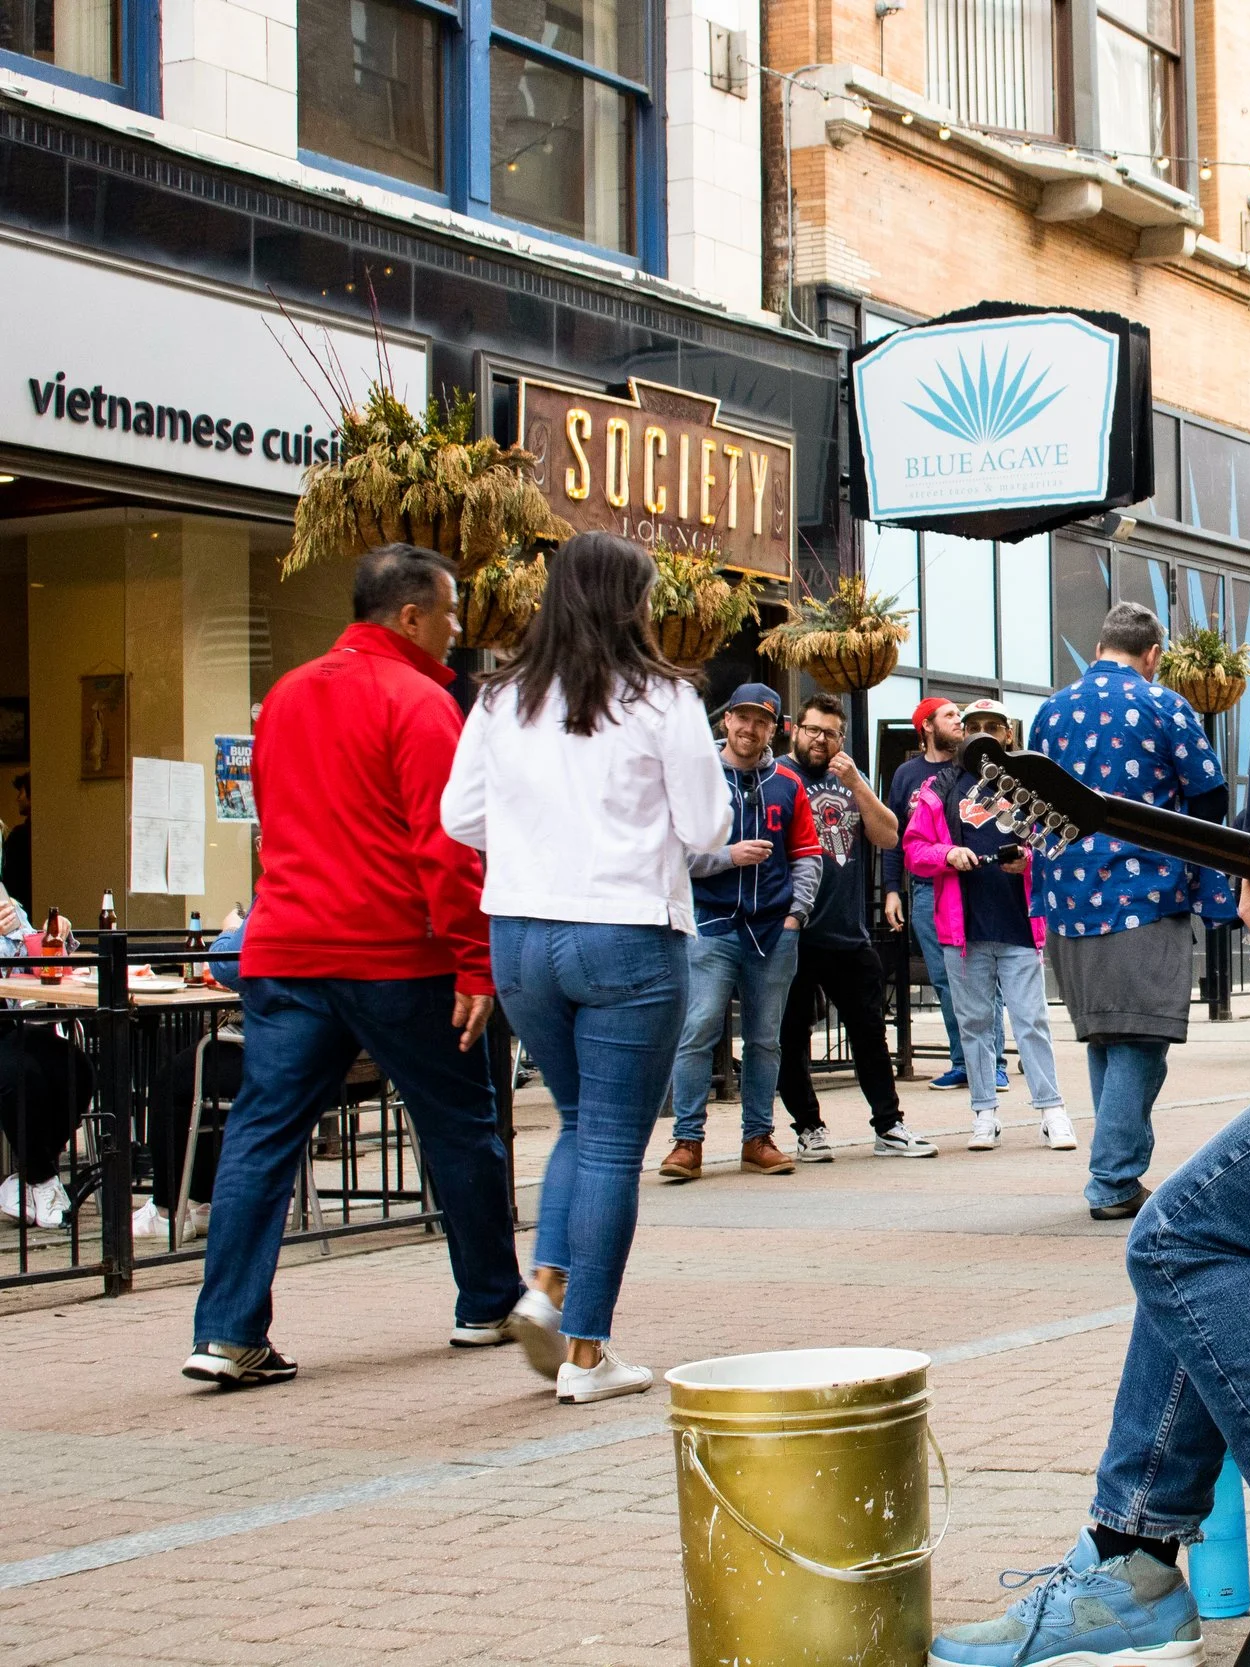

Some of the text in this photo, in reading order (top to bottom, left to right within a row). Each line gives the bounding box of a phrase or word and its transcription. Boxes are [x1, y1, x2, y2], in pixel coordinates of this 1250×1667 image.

[29, 371, 254, 455] vietnamese
[565, 408, 769, 536] SOCIETY
[905, 443, 1069, 480] BLUE AGAVE
[909, 489, 944, 499] street
[949, 486, 979, 496] tacos
[1000, 478, 1064, 492] margaritas
[230, 746, 252, 757] BUD
[806, 782, 853, 798] EVELAND
[767, 804, 783, 832] C
[824, 806, 838, 825] C
